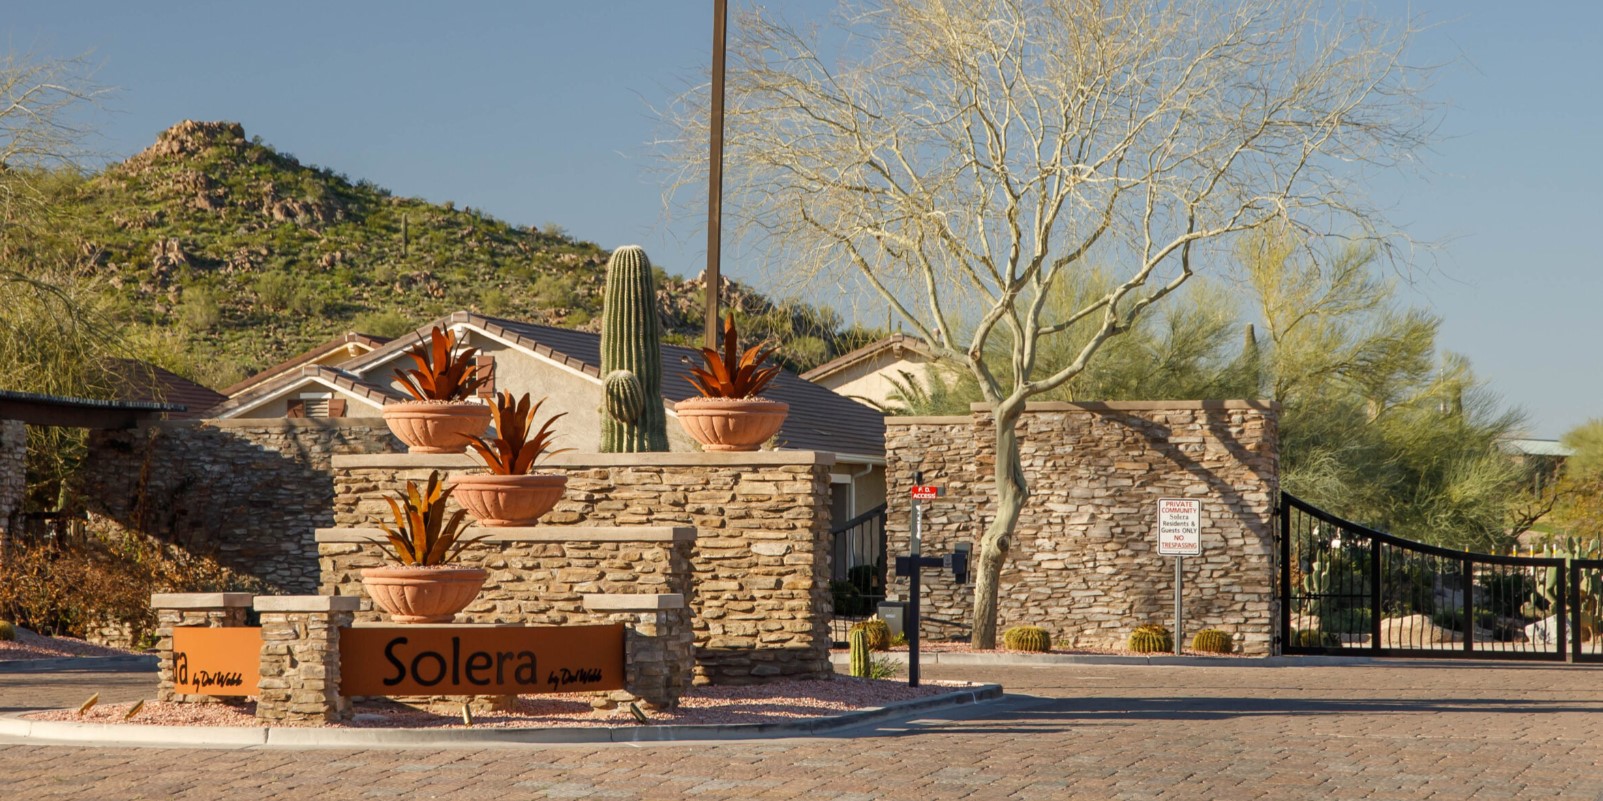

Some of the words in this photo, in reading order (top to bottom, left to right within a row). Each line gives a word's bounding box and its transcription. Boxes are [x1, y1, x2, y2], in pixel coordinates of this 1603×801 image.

[192, 672, 200, 693] by
[216, 671, 243, 688] Webb
[383, 636, 537, 686] Solera
[547, 670, 560, 692] by
[579, 668, 602, 685] Webb
